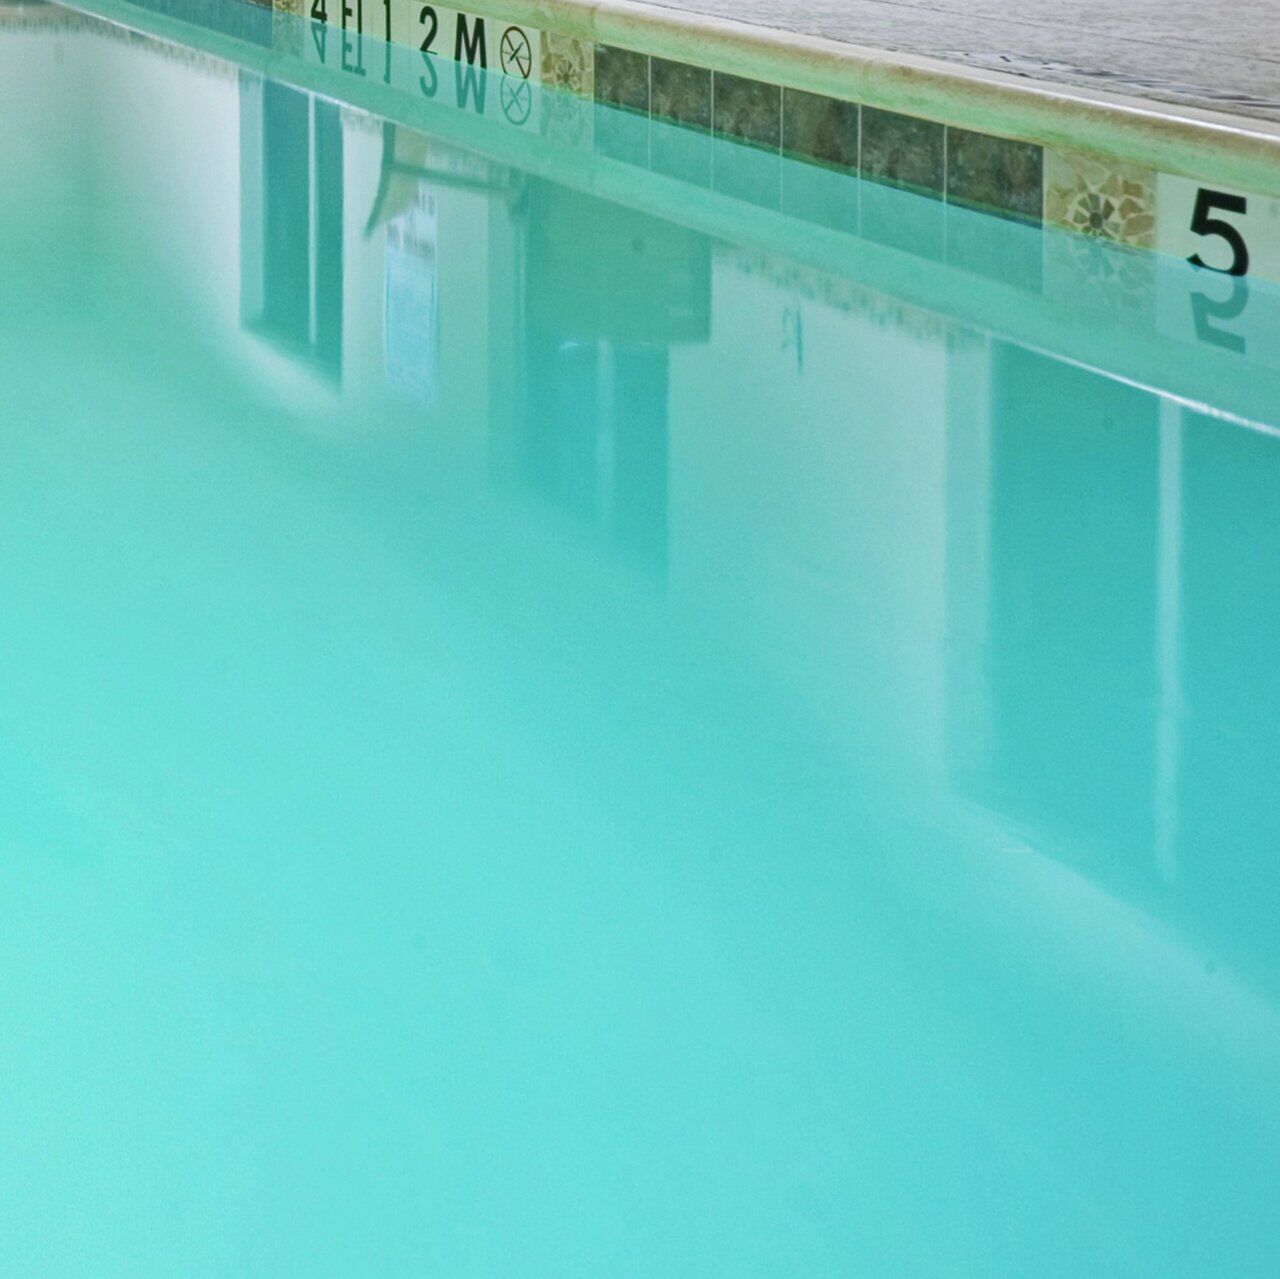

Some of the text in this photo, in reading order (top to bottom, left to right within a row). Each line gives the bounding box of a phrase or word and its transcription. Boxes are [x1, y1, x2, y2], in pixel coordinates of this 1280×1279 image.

[419, 6, 438, 55] 2
[455, 12, 487, 69] M
[1186, 187, 1249, 277] 5
